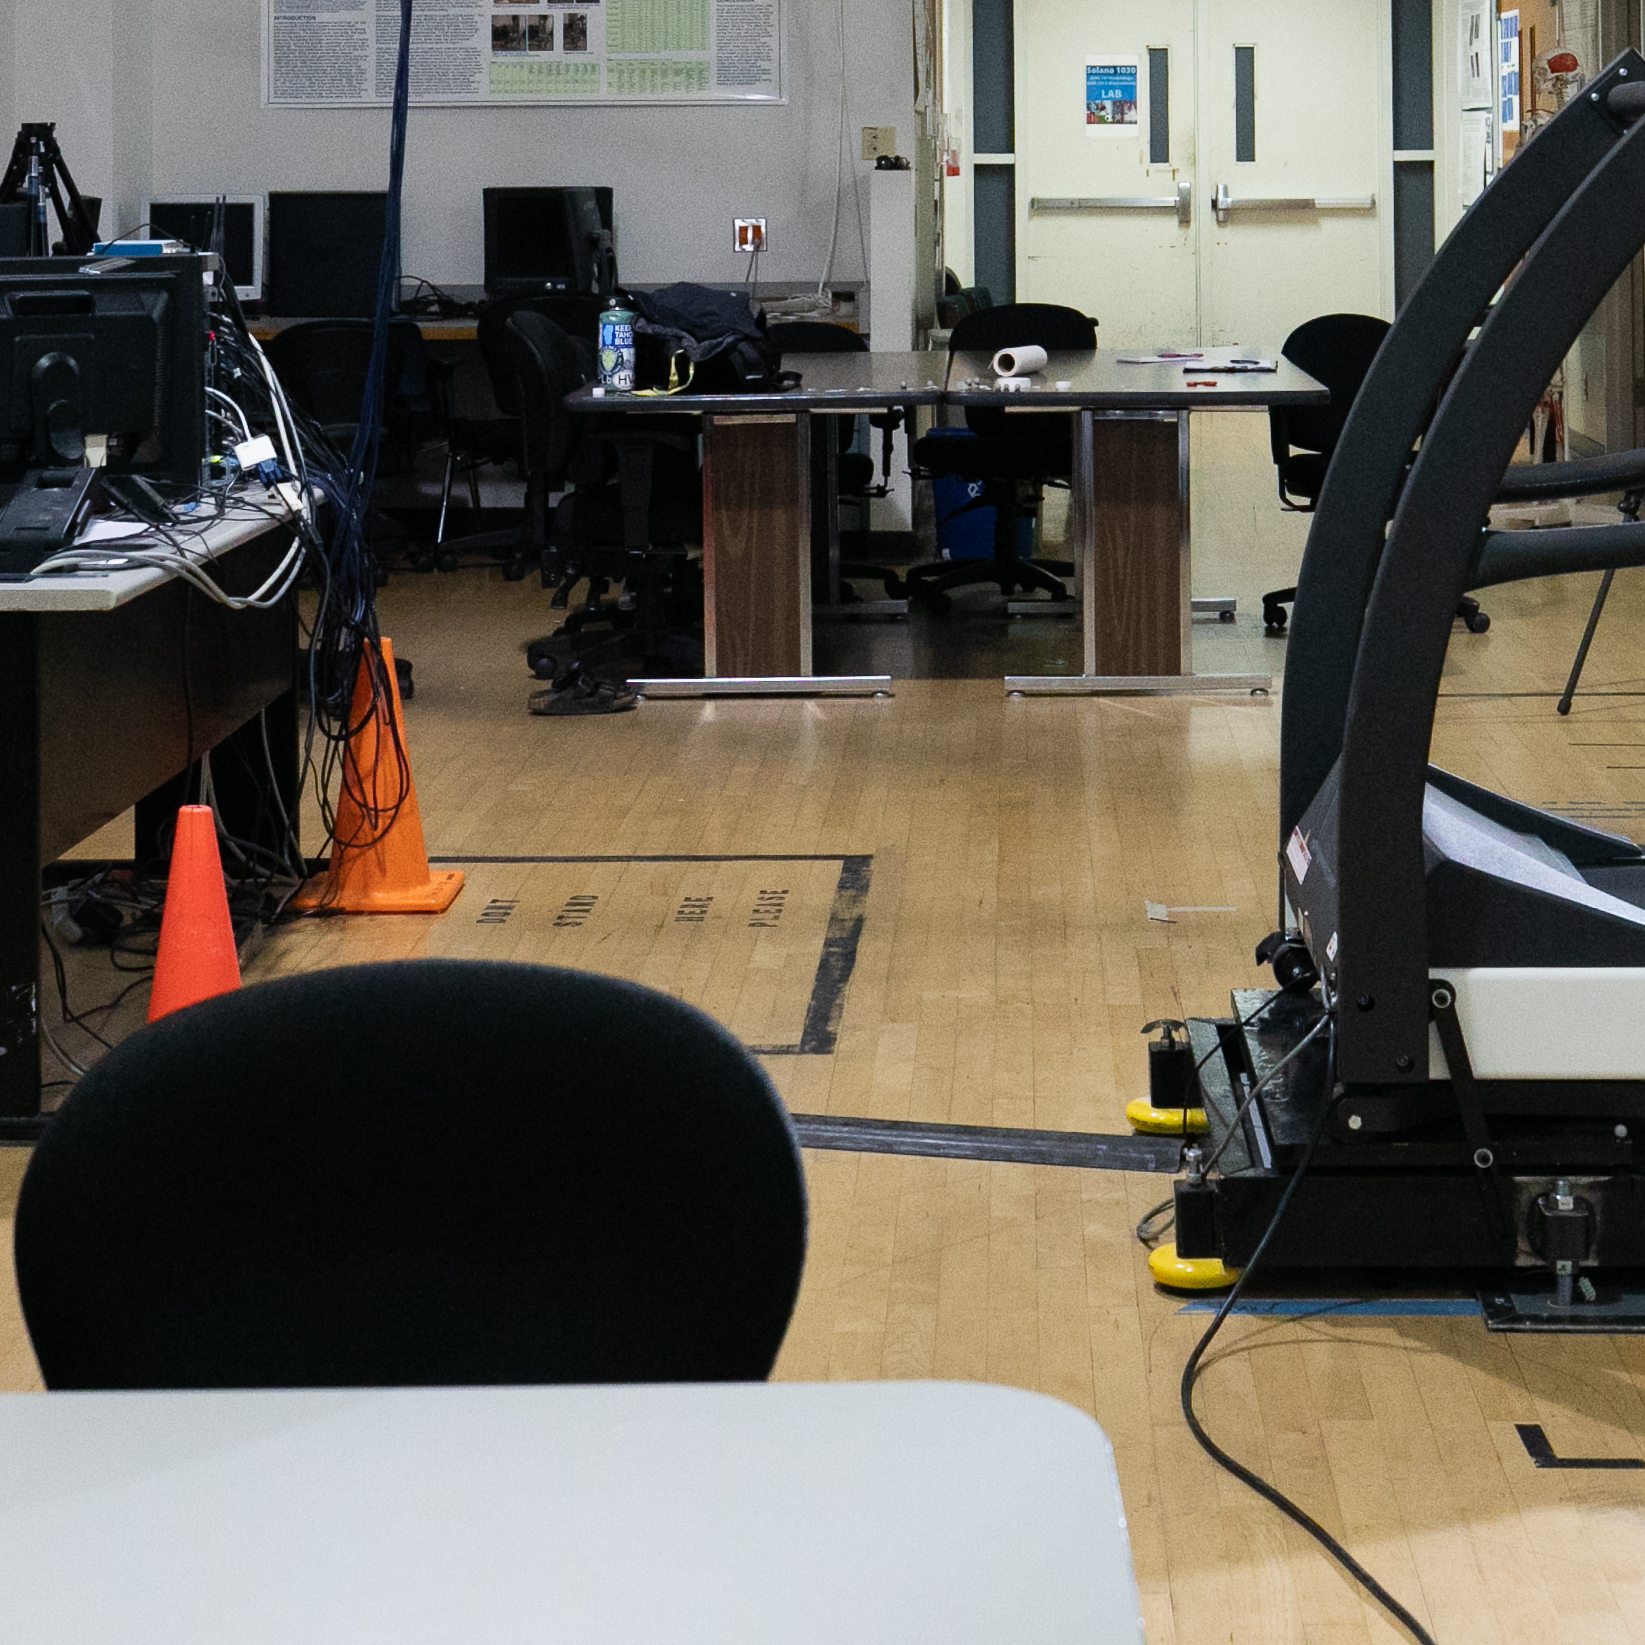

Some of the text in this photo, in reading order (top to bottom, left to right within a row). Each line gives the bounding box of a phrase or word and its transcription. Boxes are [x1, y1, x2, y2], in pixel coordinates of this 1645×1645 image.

[1087, 66, 1136, 74] Solano 1030
[1101, 89, 1122, 98] LAB
[476, 899, 520, 923] DONT
[553, 895, 599, 927] STAND
[674, 897, 714, 922] HERE
[748, 890, 789, 927] PLEASE
